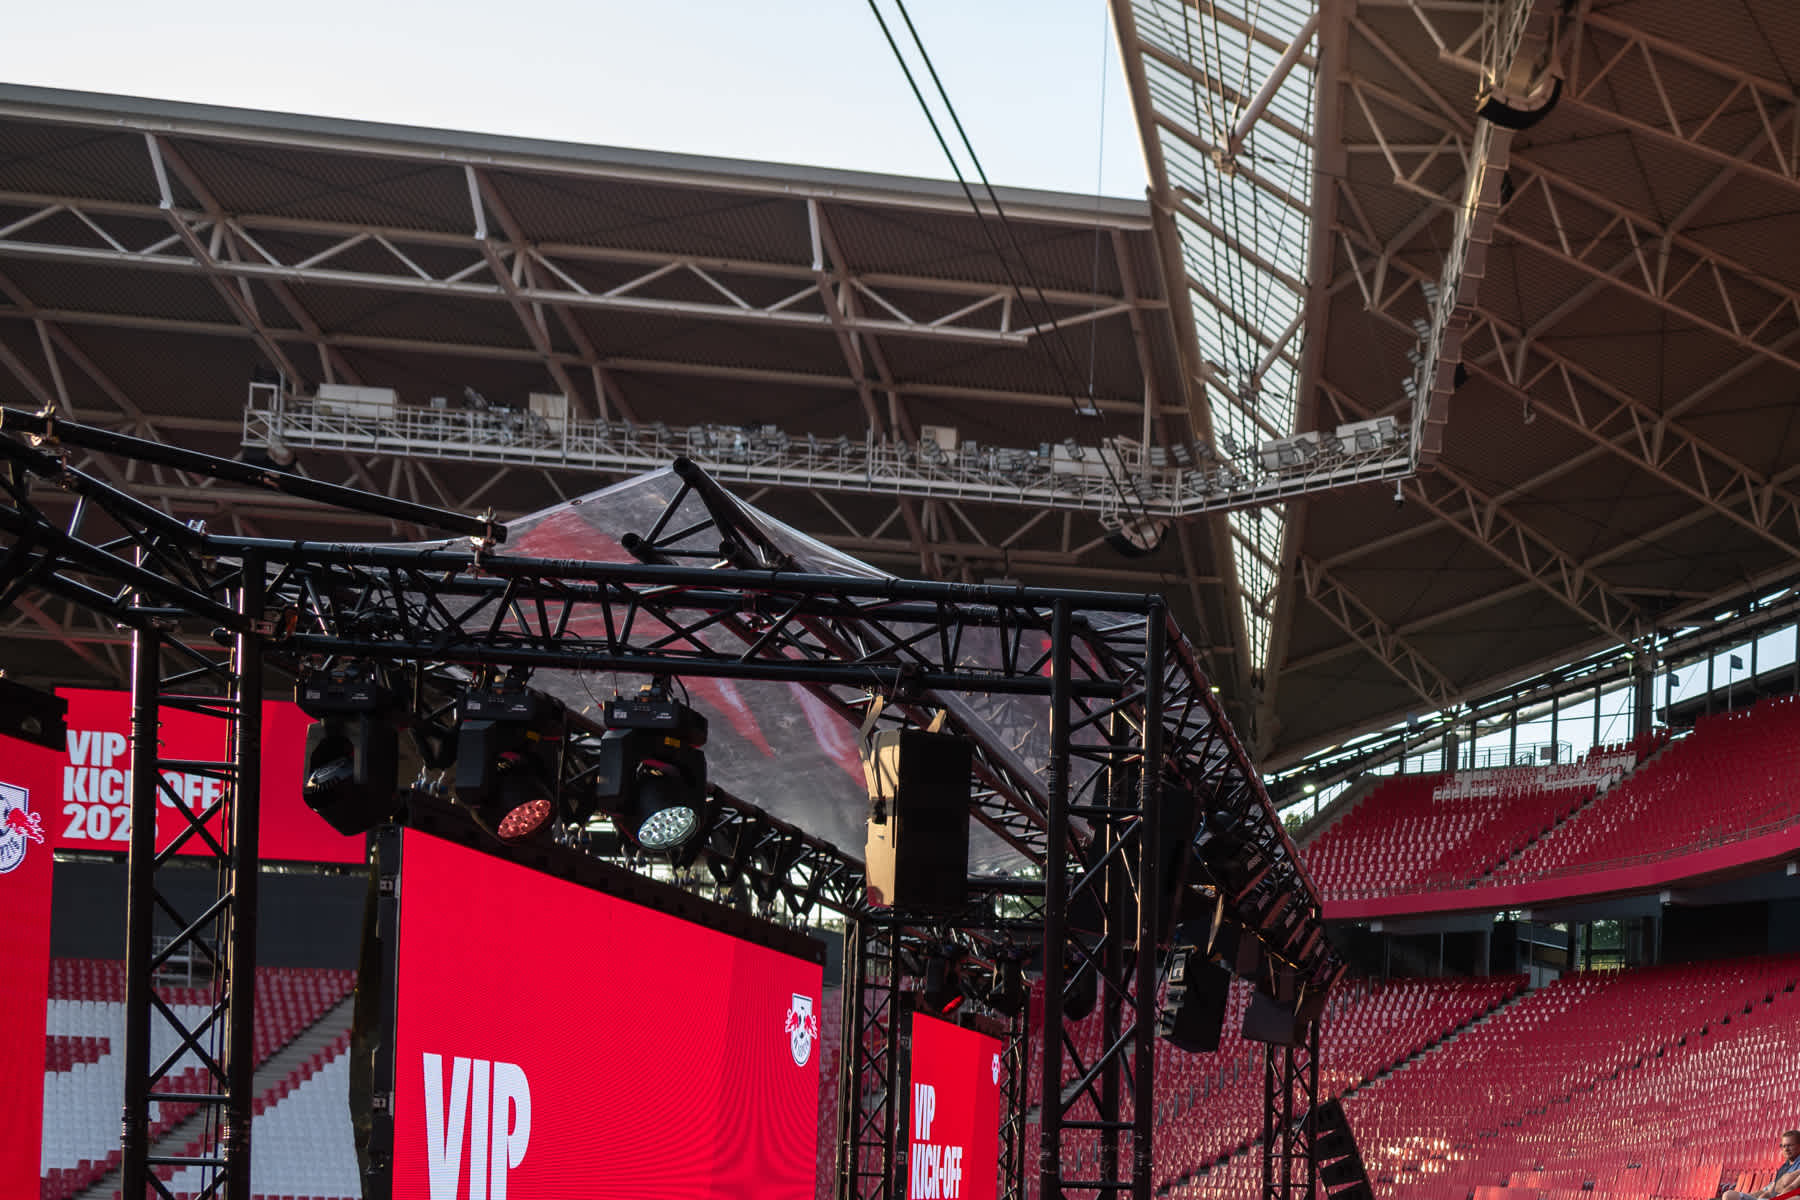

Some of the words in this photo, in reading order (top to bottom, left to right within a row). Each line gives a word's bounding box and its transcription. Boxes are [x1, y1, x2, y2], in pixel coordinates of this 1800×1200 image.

[66, 729, 127, 767] VIP
[62, 766, 222, 809] KICOFF
[62, 802, 158, 842] 202
[914, 1083, 936, 1141] VIP
[911, 1143, 963, 1200] KICK-OFF
